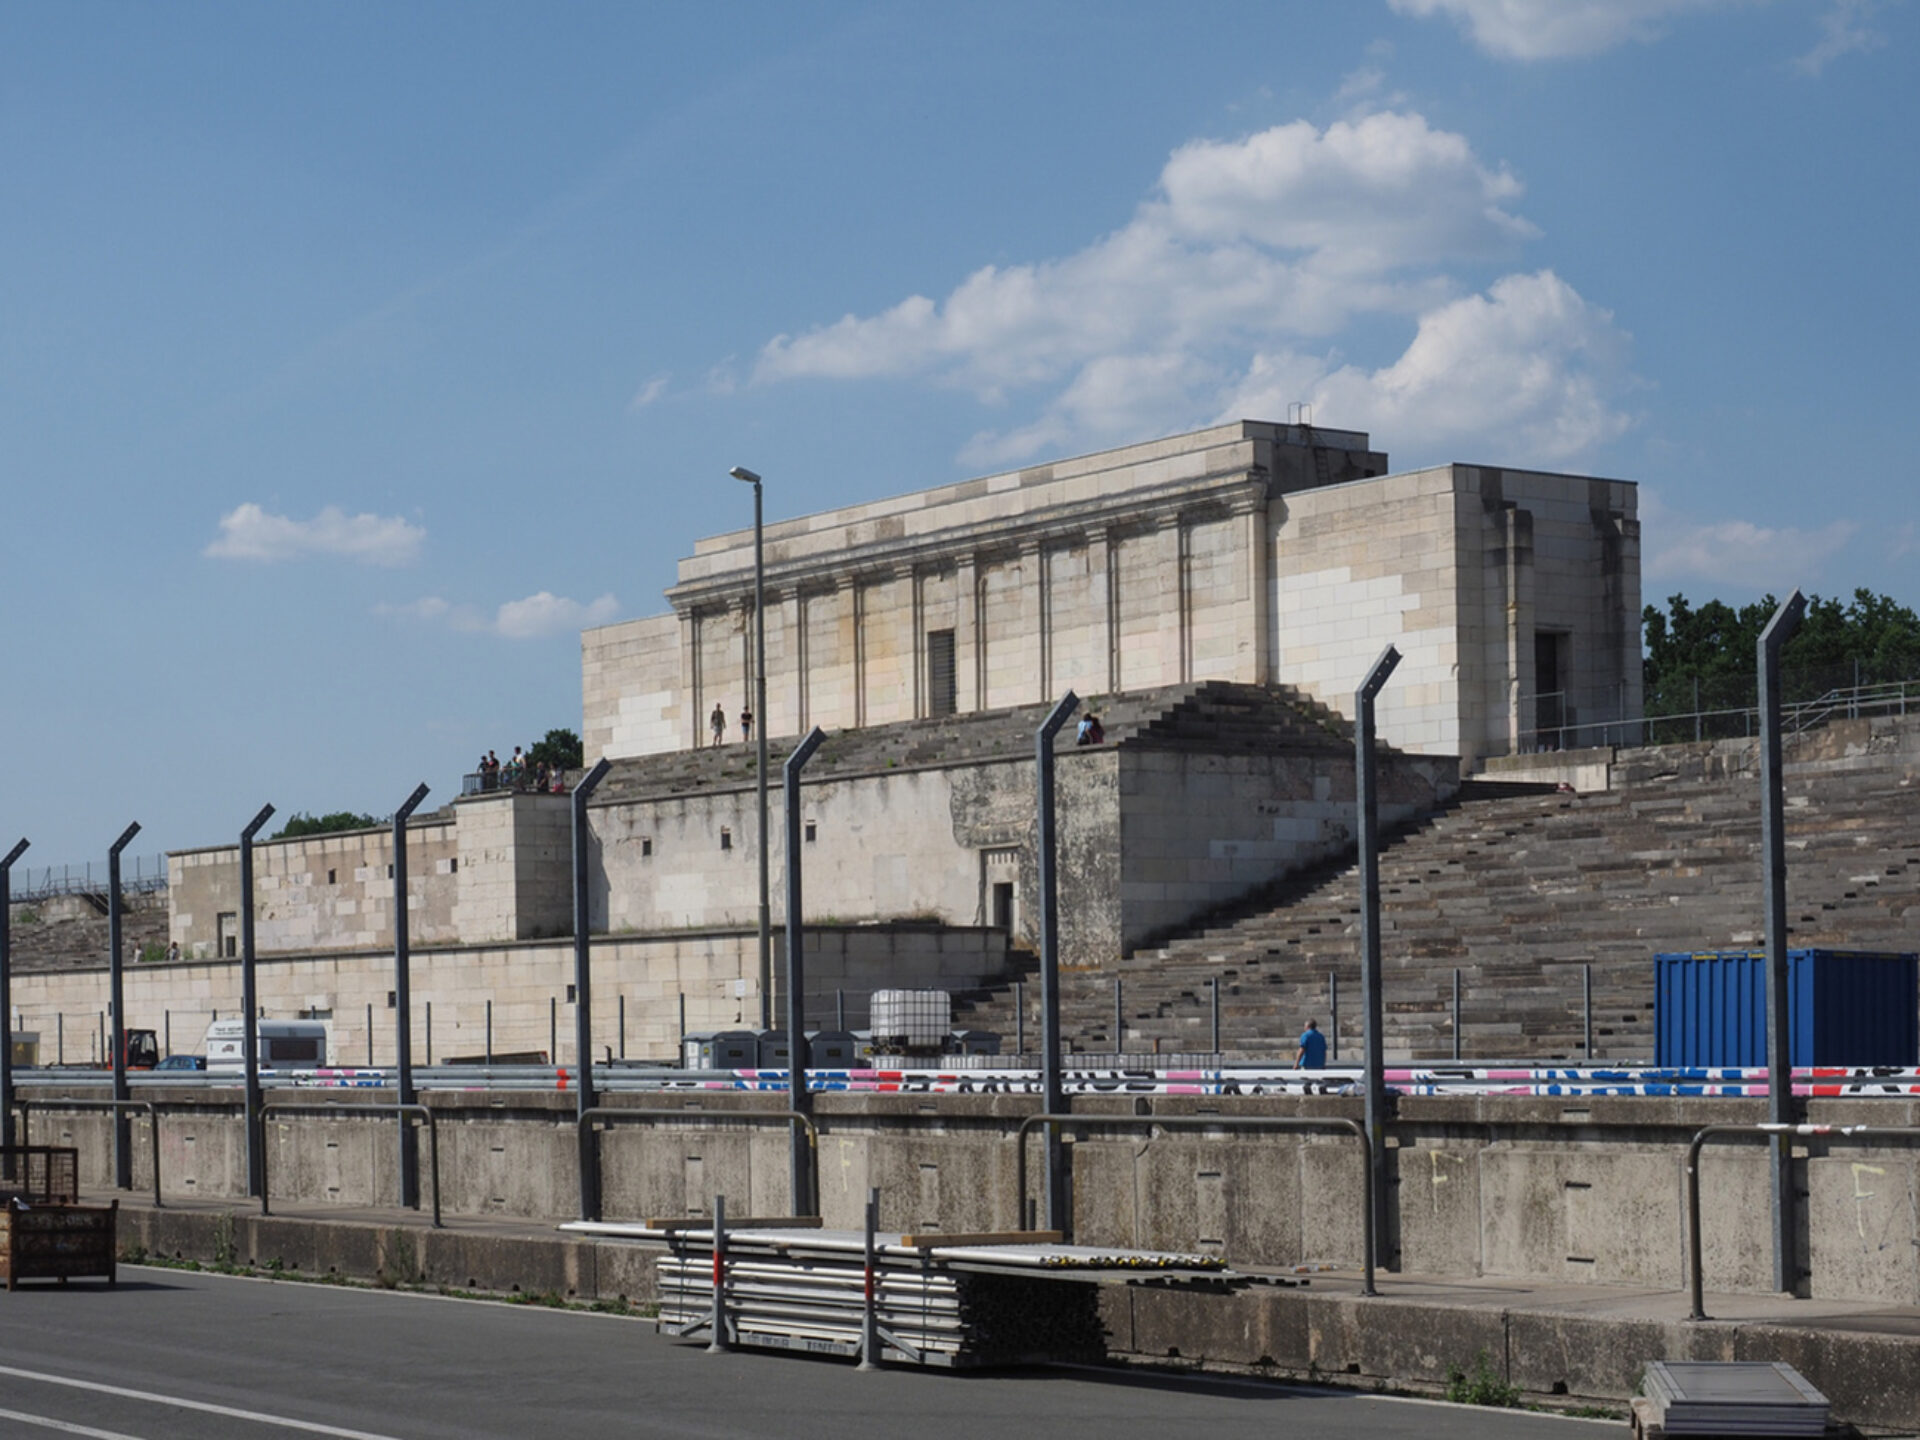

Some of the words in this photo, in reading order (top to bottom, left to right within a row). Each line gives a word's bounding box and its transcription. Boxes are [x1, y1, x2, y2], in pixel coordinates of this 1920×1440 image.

[839, 1137, 855, 1192] F
[1429, 1150, 1464, 1213] F
[1851, 1162, 1886, 1238] F
